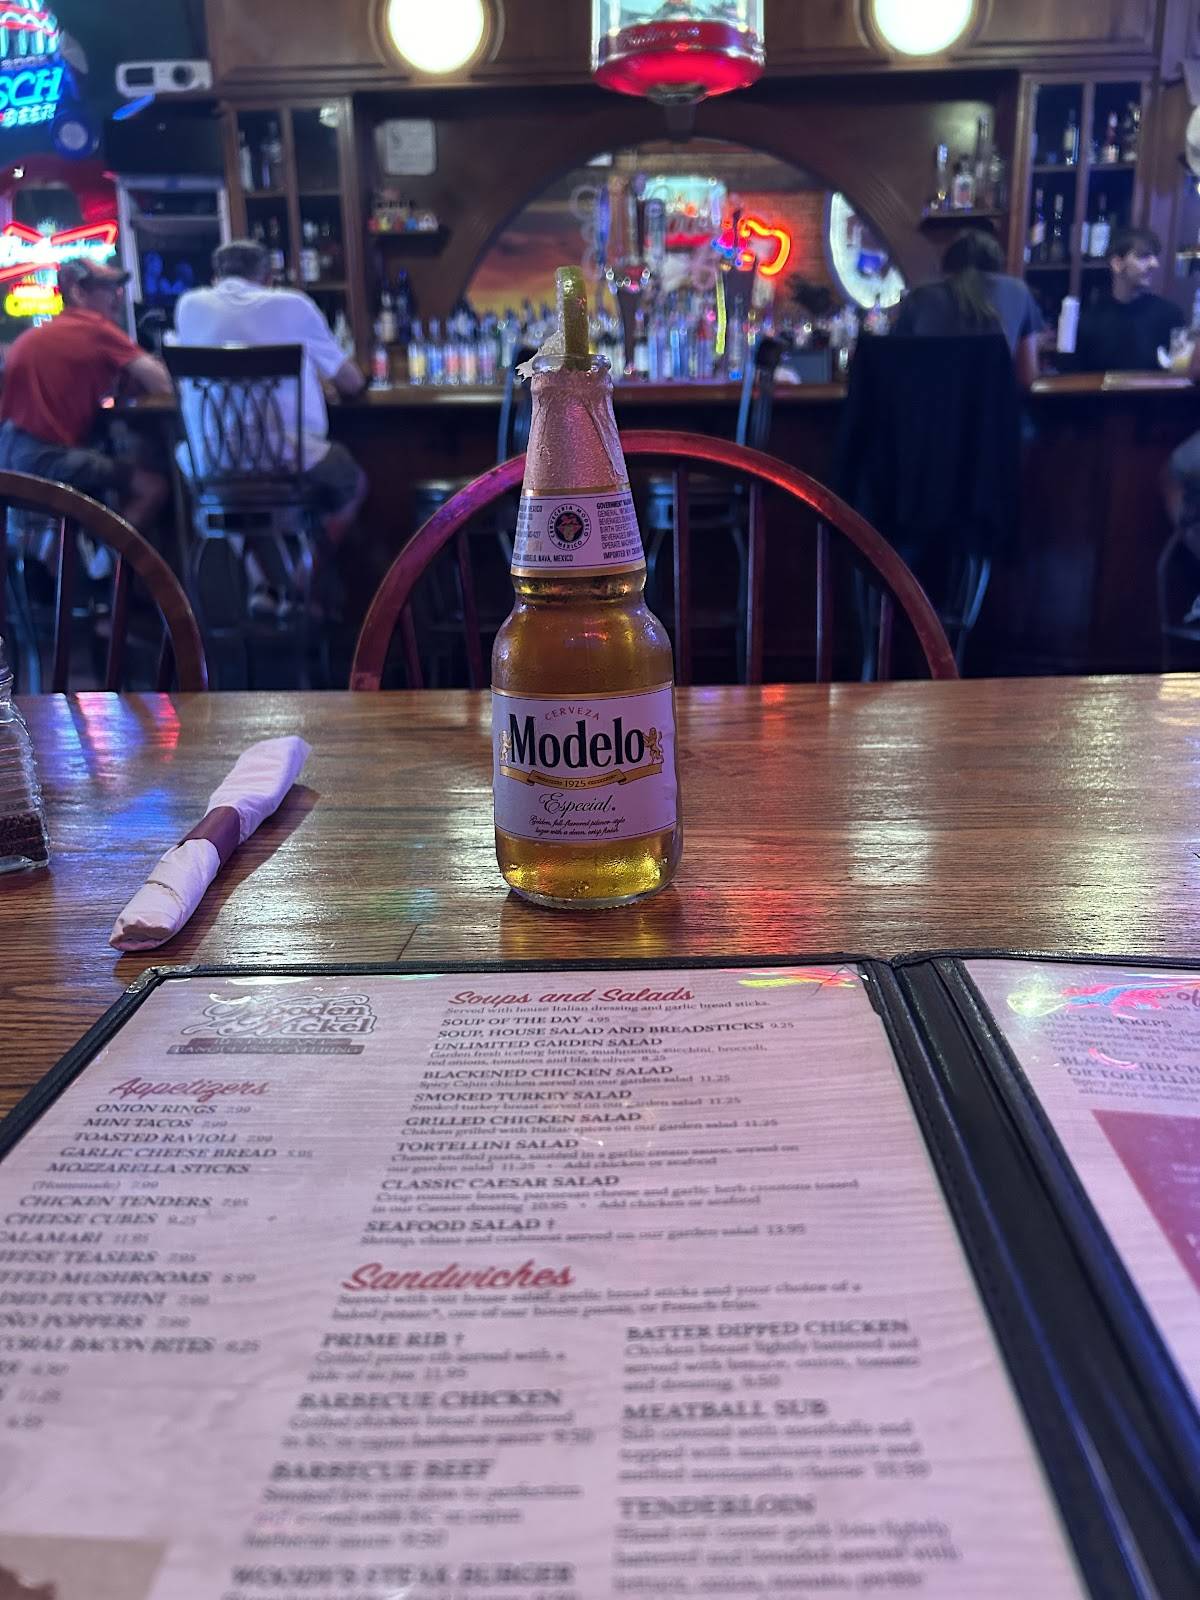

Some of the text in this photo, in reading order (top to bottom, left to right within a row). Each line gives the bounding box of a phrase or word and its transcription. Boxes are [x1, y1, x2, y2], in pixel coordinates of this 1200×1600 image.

[558, 541, 582, 549] MEXICO
[545, 706, 599, 720] CERVEZA
[509, 713, 644, 768] Modelo
[450, 987, 694, 1007] Soups and Salads
[591, 1003, 638, 1012] dressing
[641, 1003, 661, 1011] and
[665, 1002, 694, 1011] garlic
[700, 1001, 732, 1009] bread
[442, 1018, 484, 1026] SOUP
[513, 1017, 546, 1025] THE
[551, 1016, 582, 1024] DAY
[489, 1028, 546, 1037] HOUSE
[550, 1027, 604, 1036] SALAD
[608, 1026, 645, 1034] AND
[650, 1022, 764, 1034] BREADSTICKS
[433, 1038, 662, 1050] UNLIMITED GARDEN SALAD
[423, 1066, 672, 1079] BLACKENED CHICKEN SALAD
[109, 1077, 269, 1102] Appetizers
[414, 1090, 632, 1102] SMOKED TURKEY SALAD
[95, 1104, 218, 1114] ONION RINGS
[83, 1118, 194, 1128] MINI TACOS
[405, 1113, 642, 1126] GRILLED CHICKEN SALAD
[74, 1133, 237, 1143] TOASTED RAVIOLI
[397, 1139, 579, 1151] TORTELLINI SALAD
[60, 1147, 277, 1158] GARLIC CHEESE BREAD
[46, 1163, 250, 1174] MOZZARELLA STICKS
[381, 1175, 620, 1190] CLASSIC CAESAR SALAD
[19, 1195, 213, 1208] CHICKEN TENDERS
[364, 1218, 541, 1233] SEAFOOD SALAD
[341, 1259, 575, 1291] Sandwiches
[804, 1319, 910, 1335] CHICKEN
[321, 1331, 447, 1348] PRIME RIB
